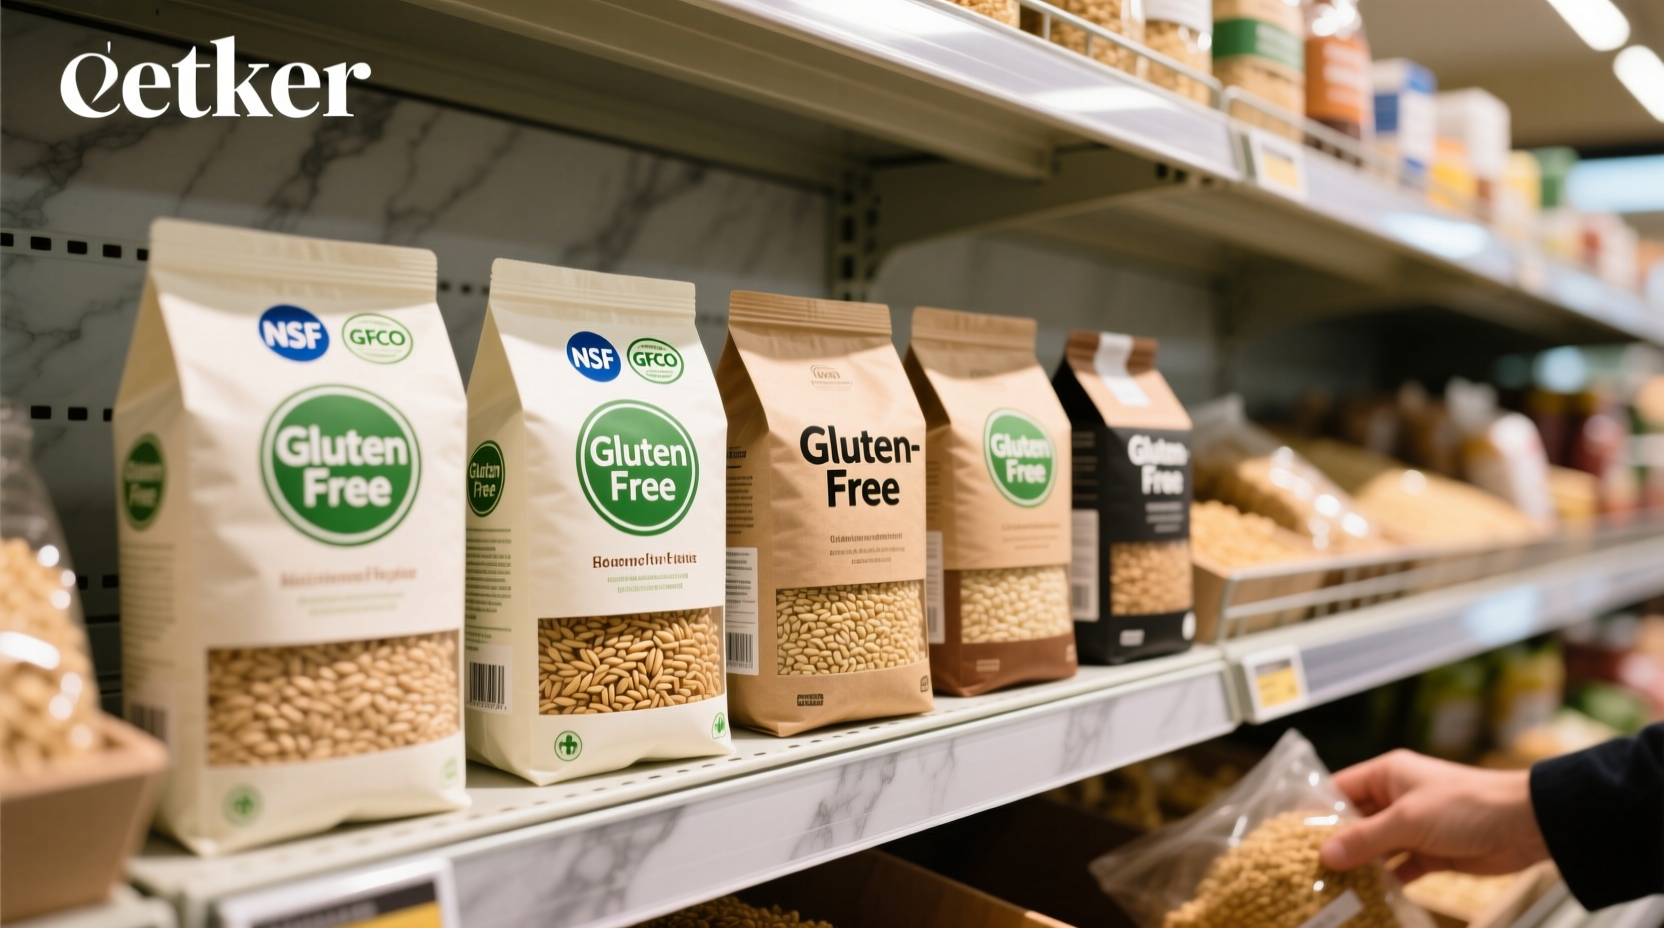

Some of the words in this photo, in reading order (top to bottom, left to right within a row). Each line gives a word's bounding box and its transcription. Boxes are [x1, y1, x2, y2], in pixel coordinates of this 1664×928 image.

[262, 320, 323, 350] NSF
[350, 328, 406, 347] GFCO
[571, 347, 614, 370] NSF
[632, 351, 678, 368] GFCO
[275, 423, 409, 468] Gluten
[589, 434, 688, 467] Gluten
[800, 425, 920, 465] Gluten-
[990, 432, 1052, 459] Gluten
[610, 470, 676, 501] Free
[1005, 458, 1047, 483] Free
[1141, 464, 1184, 495] Free
[303, 467, 394, 509] Free
[473, 481, 496, 498] Free
[826, 469, 900, 507] Free
